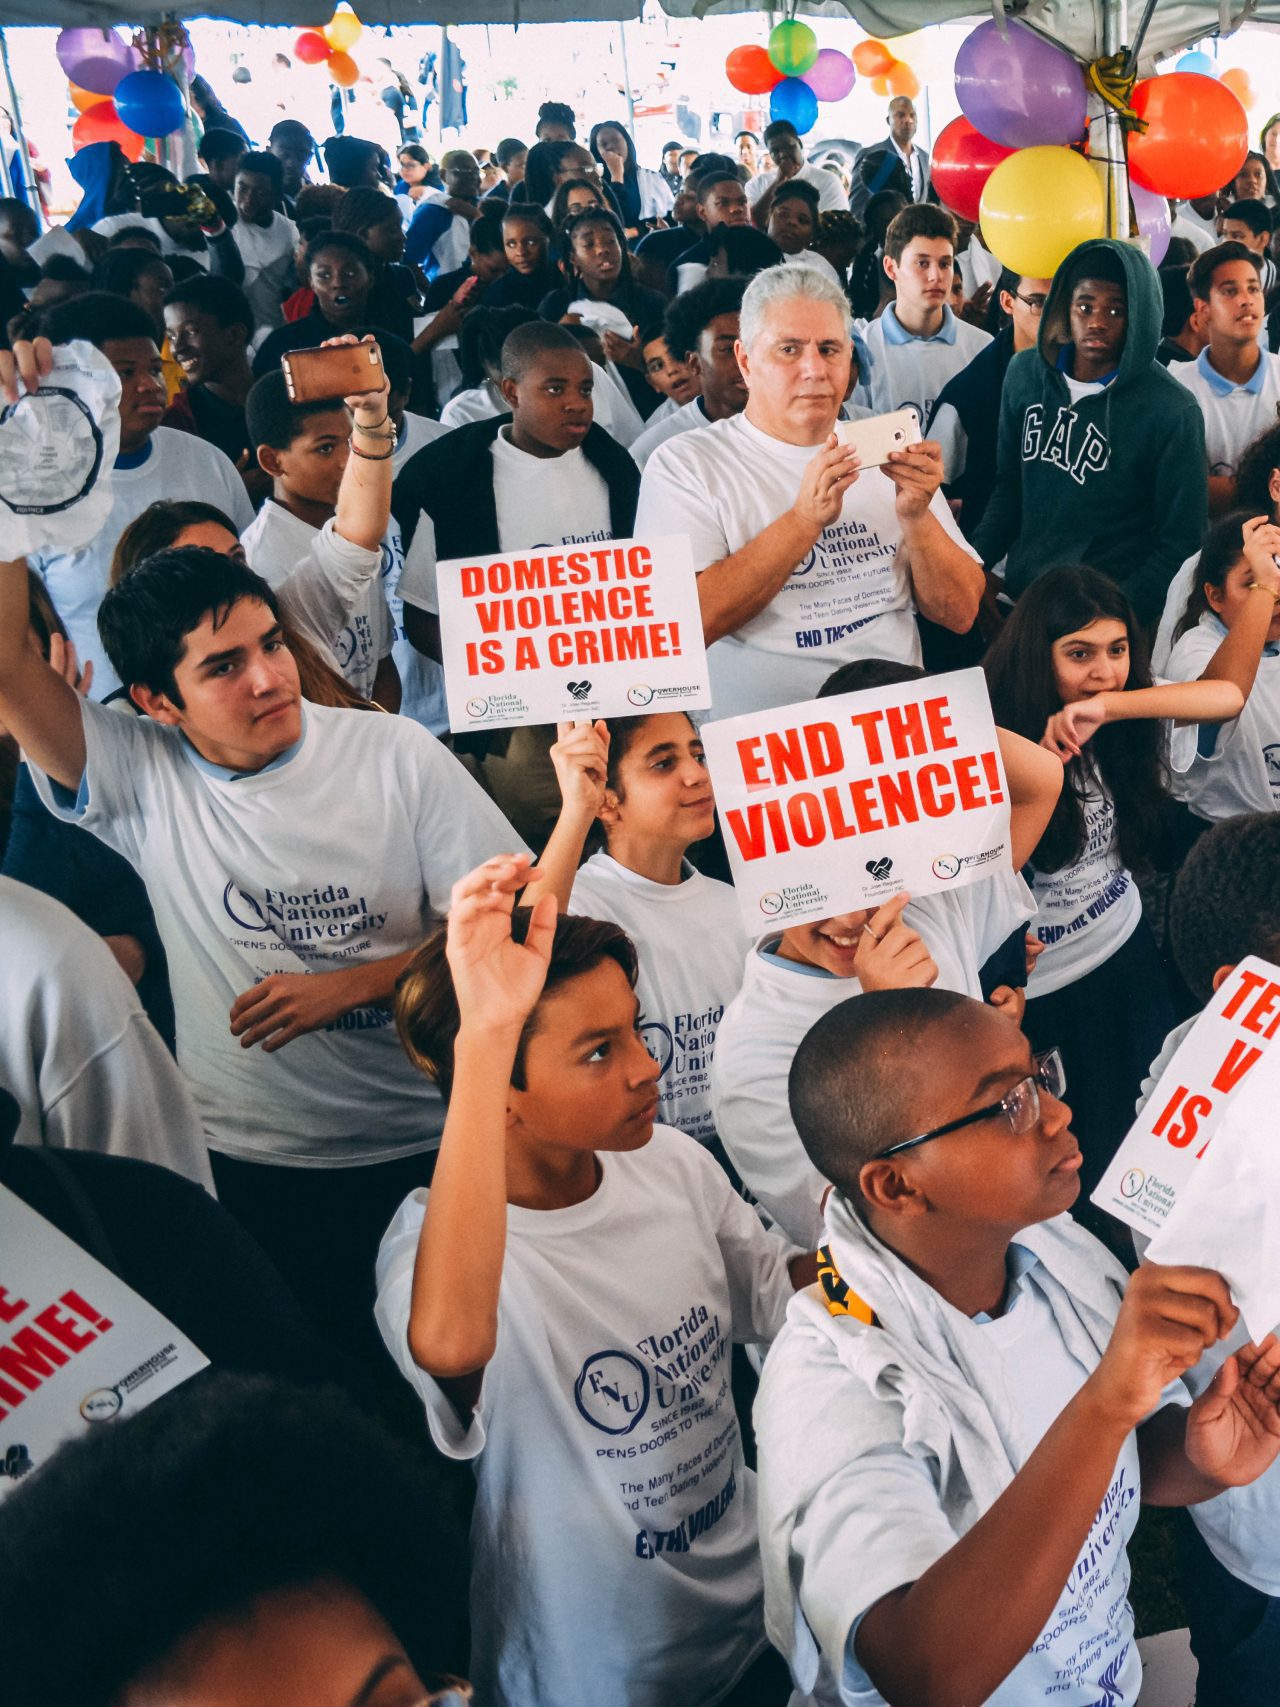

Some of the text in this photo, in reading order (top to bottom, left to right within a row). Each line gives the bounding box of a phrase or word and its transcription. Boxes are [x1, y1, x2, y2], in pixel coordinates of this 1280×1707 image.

[1022, 403, 1111, 485] GAP
[815, 533, 880, 555] National
[822, 521, 867, 540] lorida
[821, 543, 897, 569] University
[460, 546, 652, 598] DOMESTIC
[476, 585, 654, 633] VIOLENCE
[466, 622, 682, 676] IS A CRIME!
[795, 629, 822, 648] END
[736, 696, 958, 793] END THE
[725, 751, 1004, 862] VIOLENCE!
[265, 885, 350, 906] Florida
[782, 883, 814, 896] Florida
[785, 894, 829, 909] University
[266, 897, 368, 922] National
[270, 911, 389, 941] University
[1038, 925, 1066, 944] END
[333, 940, 372, 960] FUTURE
[675, 1005, 724, 1034] Florid
[675, 1029, 716, 1052] Natio
[686, 1087, 697, 1095] TO
[689, 1073, 708, 1083] 1982
[704, 1111, 712, 1121] of
[1151, 1085, 1212, 1149] IS
[636, 1305, 709, 1362] Florida
[0, 1289, 114, 1422] IME!
[654, 1314, 721, 1386] National
[114, 1343, 177, 1390] POWERHOUSE
[589, 1370, 639, 1413] FNU
[651, 1398, 705, 1432] SINCE 1982
[597, 1442, 636, 1459] PENS
[640, 1430, 678, 1455] DOORS
[679, 1417, 693, 1430] TO
[620, 1444, 712, 1494] The Many Faces of
[644, 1471, 700, 1510] Teen Dating
[1082, 1569, 1100, 1592] 1982
[1043, 1576, 1112, 1643] DOORS THE
[1079, 1629, 1109, 1651] Faces
[1044, 1682, 1070, 1696] and
